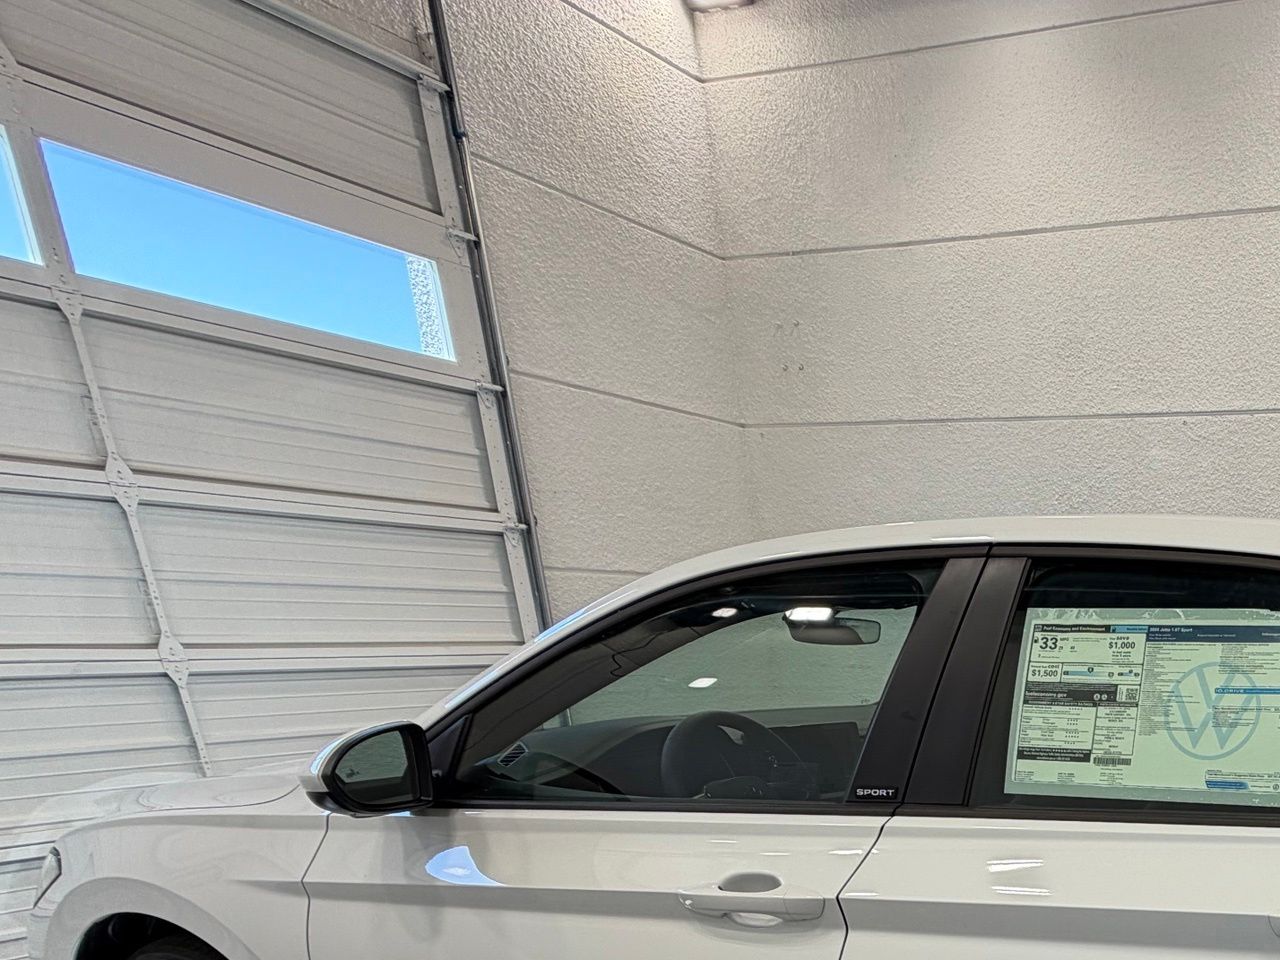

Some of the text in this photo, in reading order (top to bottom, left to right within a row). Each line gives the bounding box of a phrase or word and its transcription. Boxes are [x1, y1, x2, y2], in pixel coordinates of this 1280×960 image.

[1039, 637, 1058, 650] 33
[1108, 641, 1136, 649] $1,000
[1031, 669, 1058, 677] $1,500
[856, 788, 895, 796] SPORT
